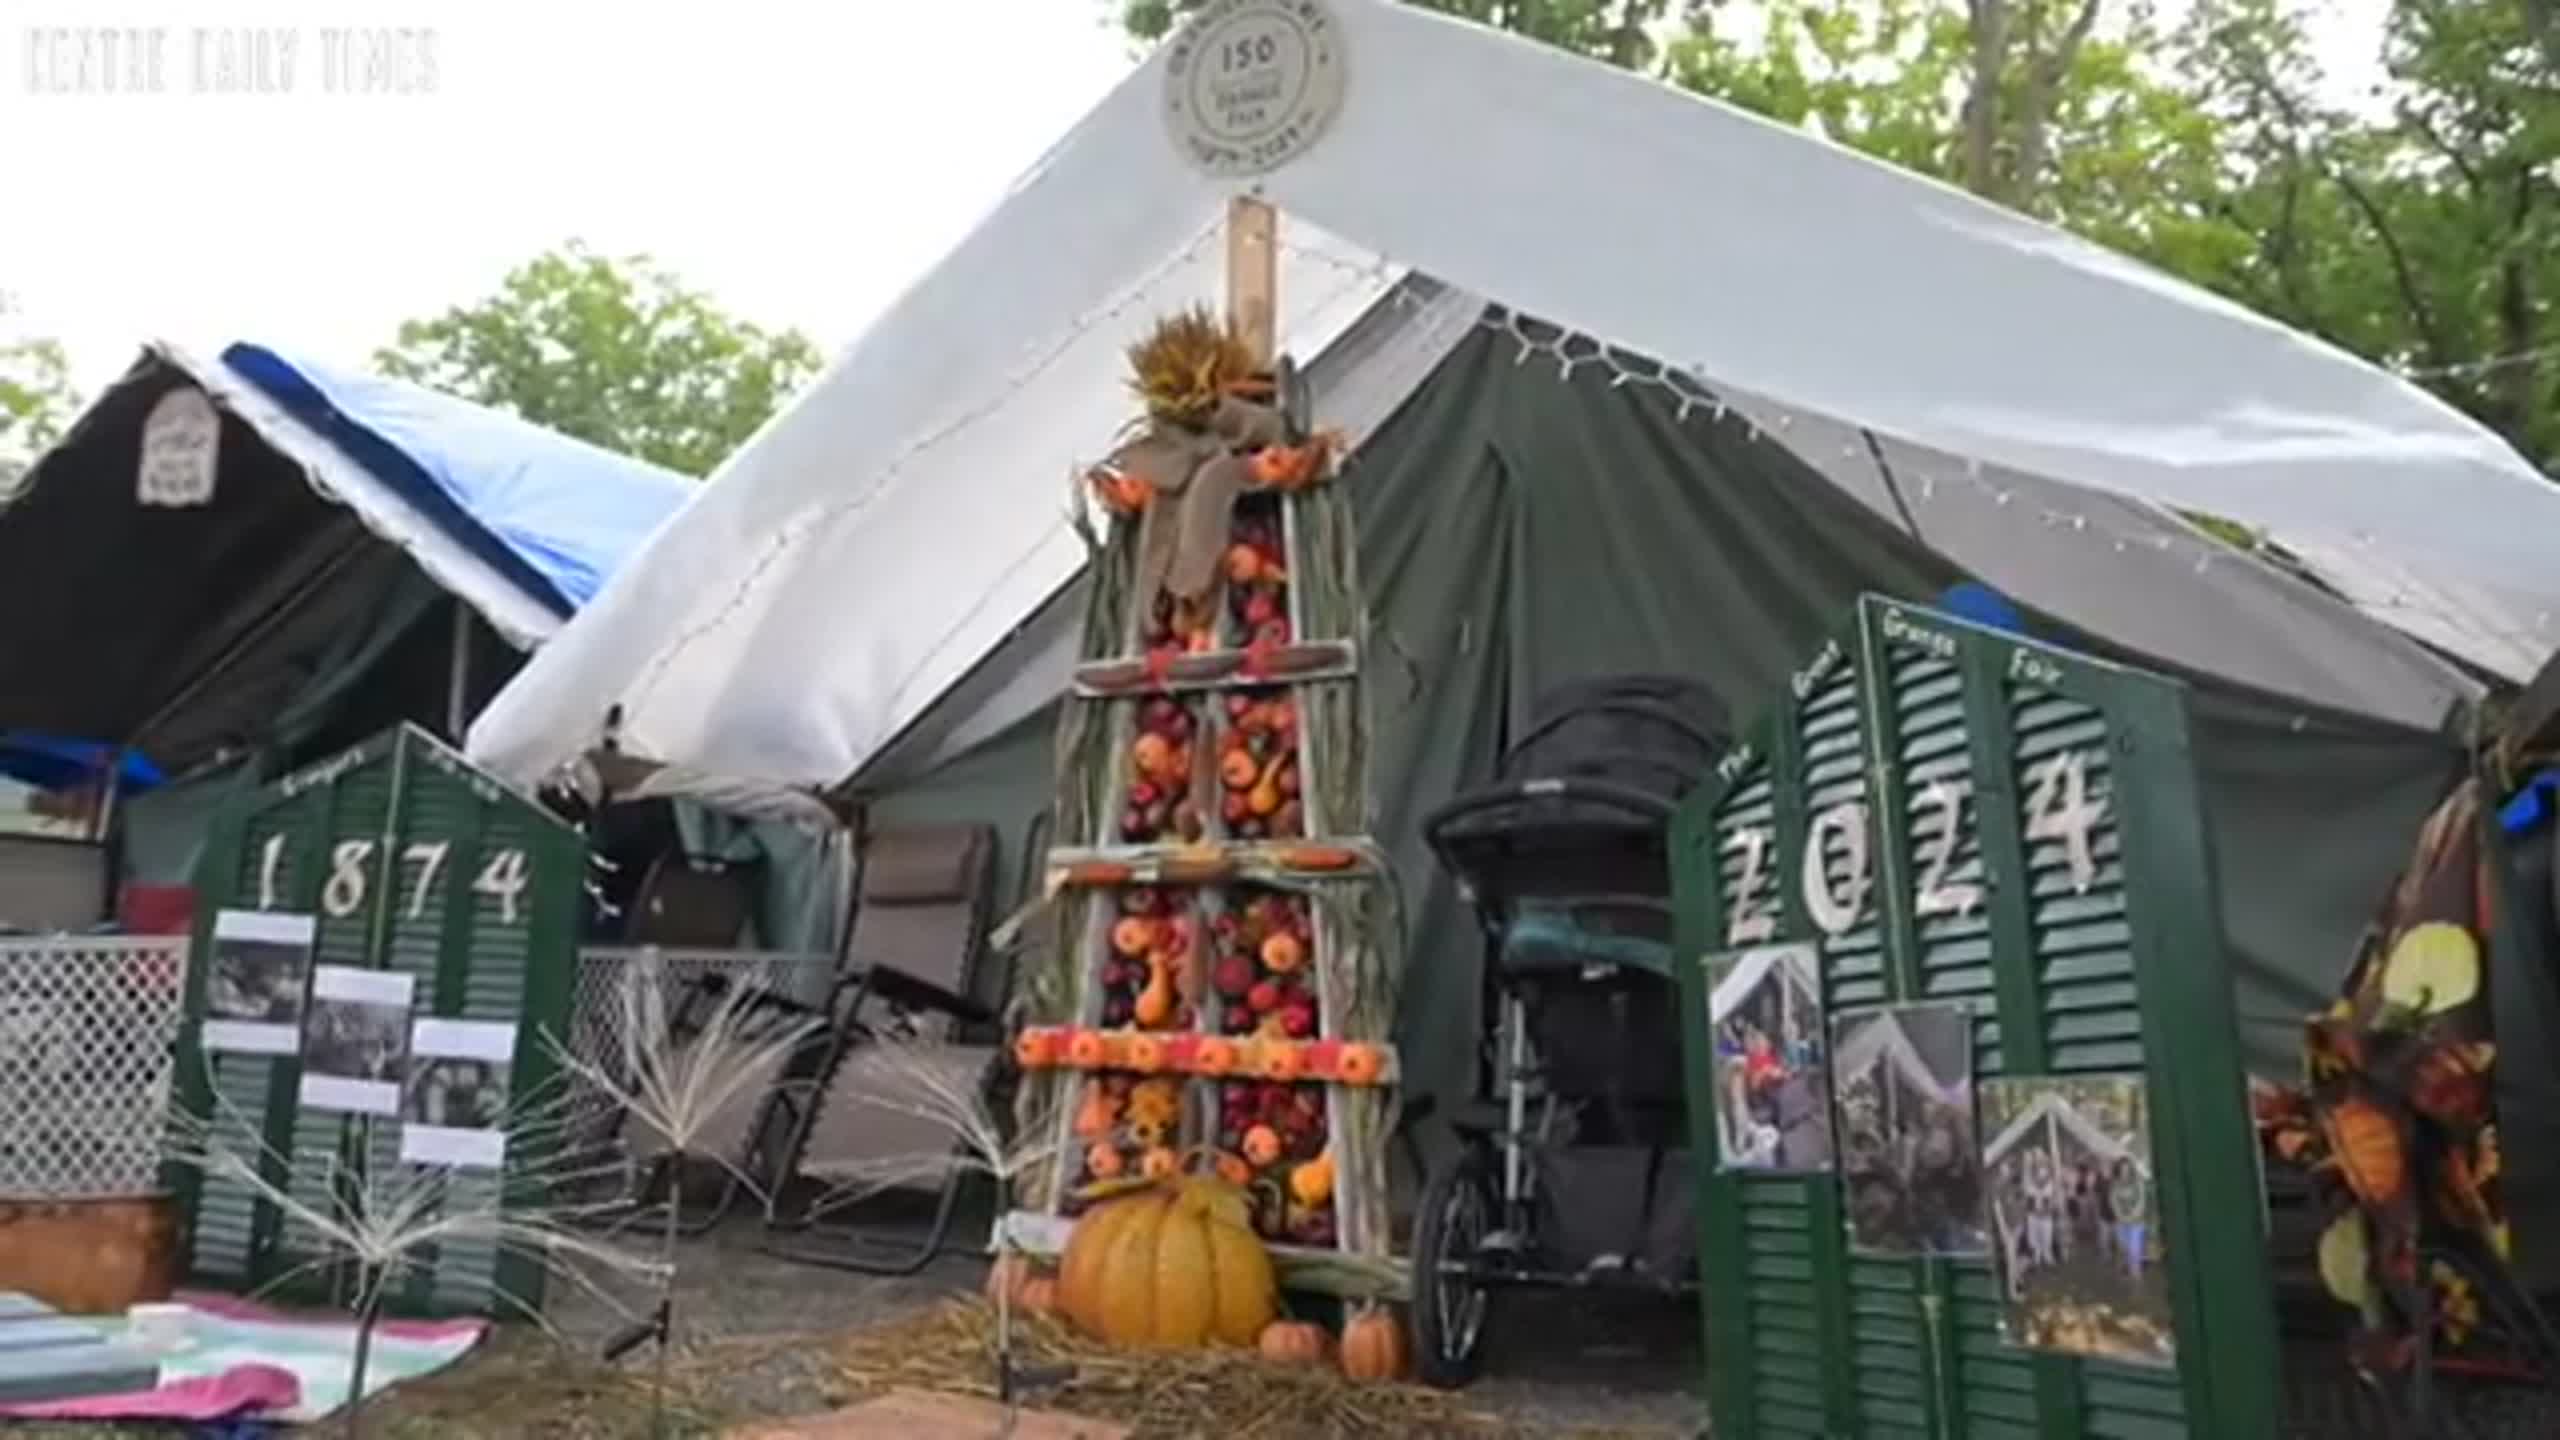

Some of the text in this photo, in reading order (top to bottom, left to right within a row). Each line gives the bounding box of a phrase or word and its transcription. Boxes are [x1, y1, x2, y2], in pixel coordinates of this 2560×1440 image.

[1222, 34, 1276, 72] 150
[2009, 647, 2064, 684] Fair
[258, 833, 528, 923] 1874
